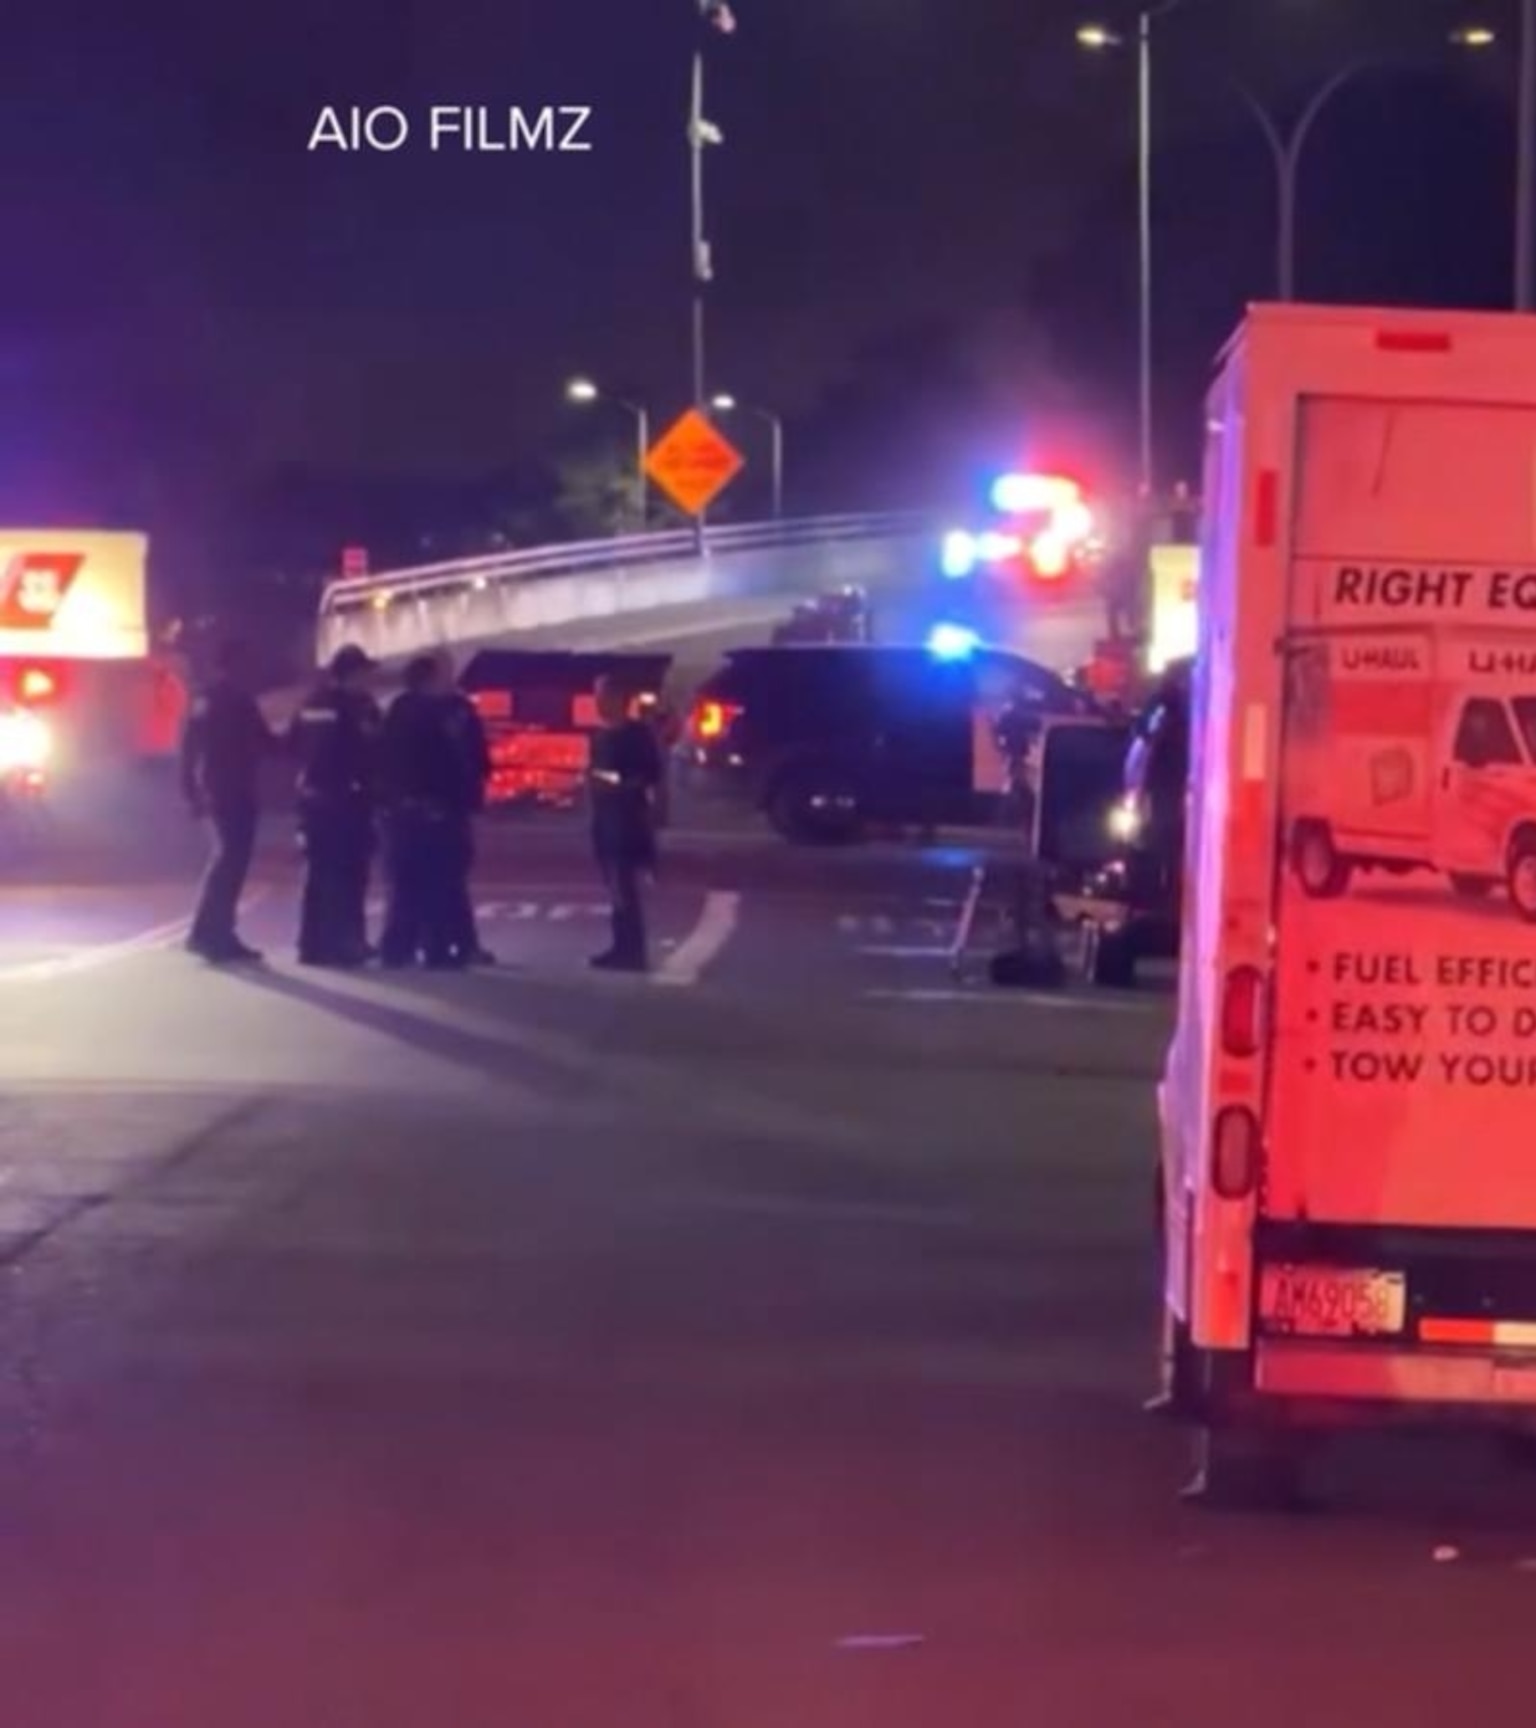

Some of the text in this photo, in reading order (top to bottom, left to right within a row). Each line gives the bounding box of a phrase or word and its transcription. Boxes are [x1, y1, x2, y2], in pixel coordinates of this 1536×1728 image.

[1335, 567, 1473, 606] RIGHT
[1331, 953, 1422, 986] FUEL
[1331, 1002, 1428, 1033] EASY
[1446, 1005, 1498, 1037] TO
[1329, 1051, 1424, 1082] TOW
